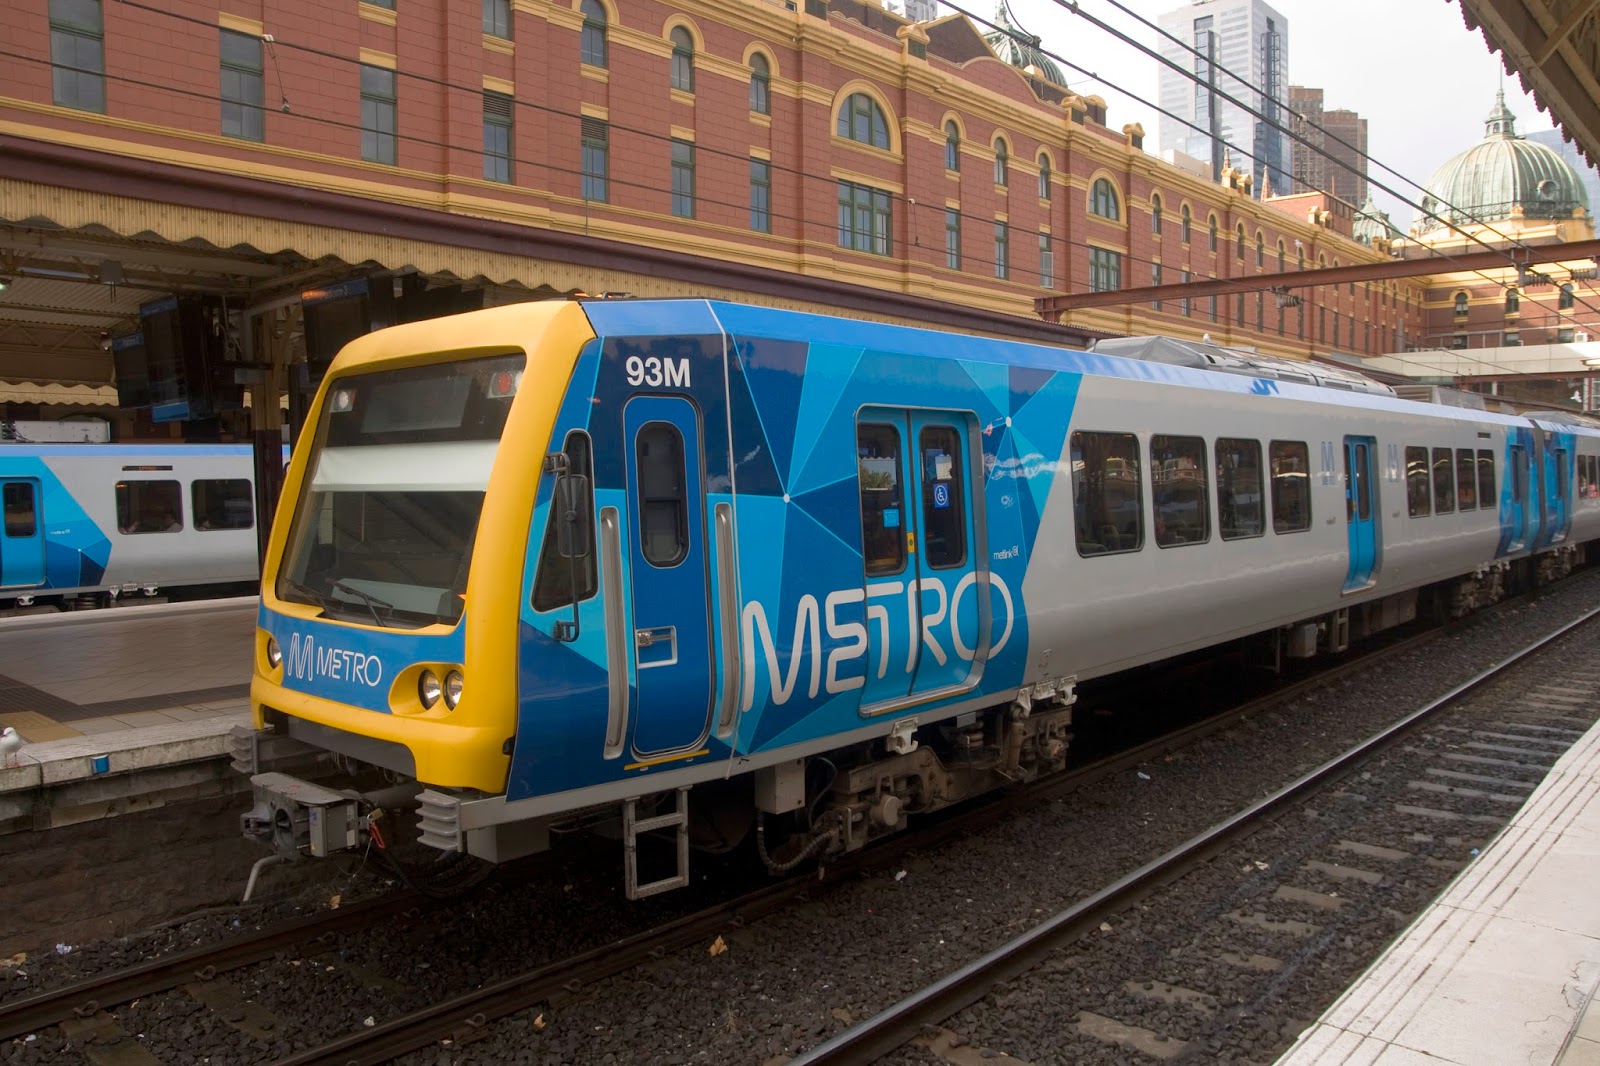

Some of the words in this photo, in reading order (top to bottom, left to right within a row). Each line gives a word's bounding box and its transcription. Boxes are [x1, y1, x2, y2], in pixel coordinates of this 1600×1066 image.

[625, 355, 691, 388] 93M
[742, 571, 1014, 712] METRO
[316, 646, 382, 687] METRO
